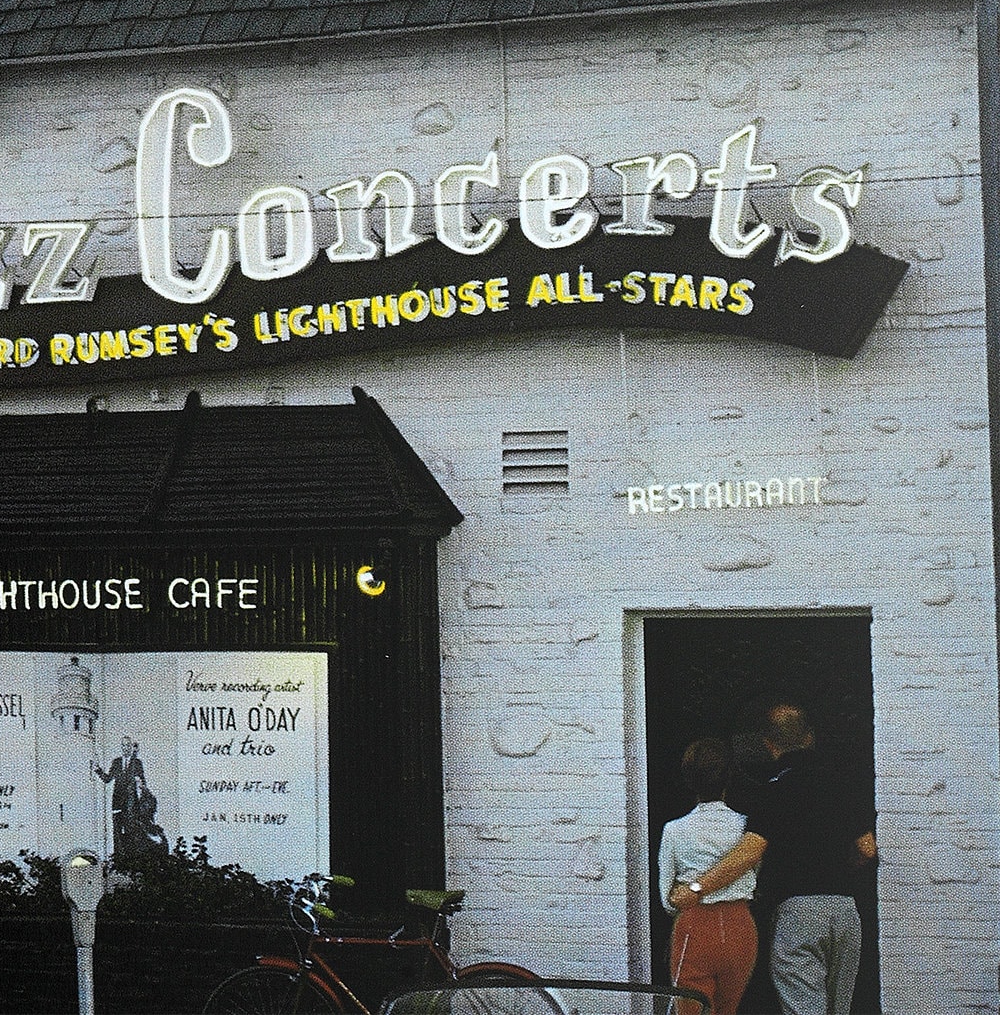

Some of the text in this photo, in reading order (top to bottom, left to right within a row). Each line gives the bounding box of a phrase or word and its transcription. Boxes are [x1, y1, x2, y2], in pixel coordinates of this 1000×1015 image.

[134, 86, 866, 305] Concerts
[51, 312, 239, 366] RUMSEY'S
[254, 277, 509, 344] LIGHTHOUSE
[626, 476, 828, 515] RESTAURANT
[168, 578, 260, 609] CAFE
[221, 677, 271, 701] recording
[187, 703, 301, 732] ANITA O'DAY
[201, 735, 276, 756] and trio
[199, 780, 239, 793] SUNDAY
